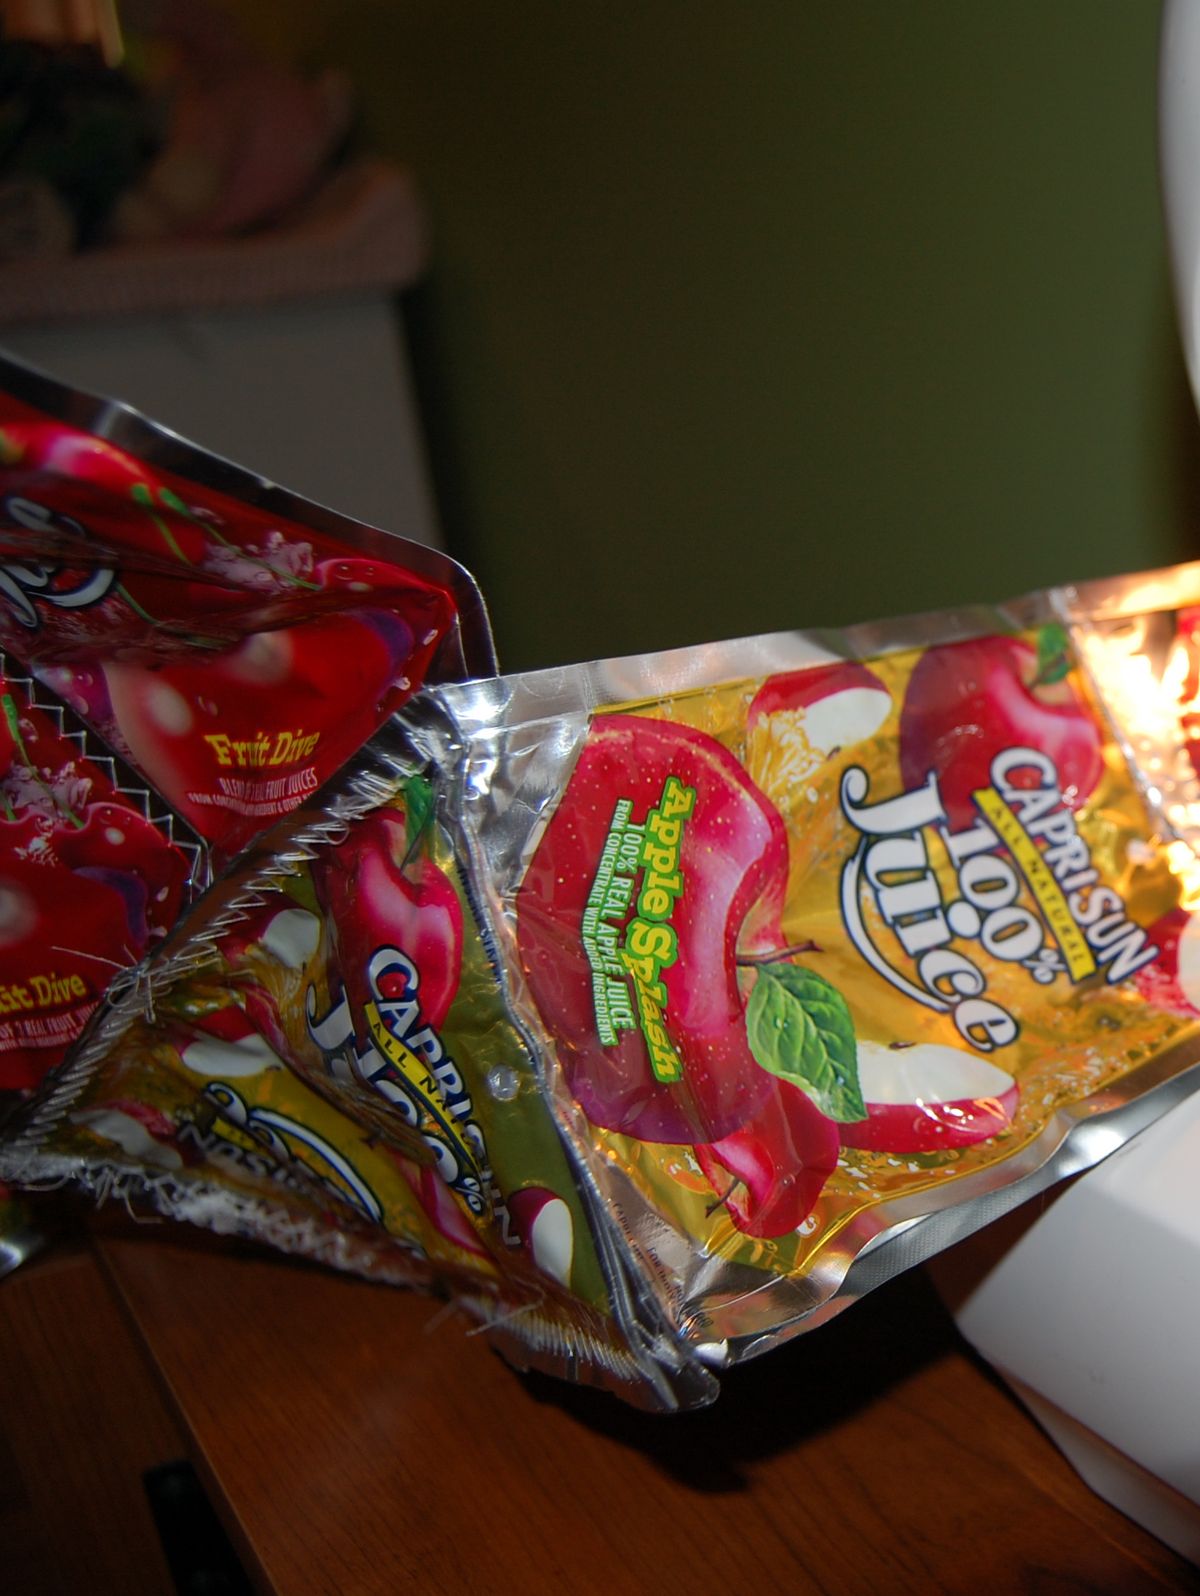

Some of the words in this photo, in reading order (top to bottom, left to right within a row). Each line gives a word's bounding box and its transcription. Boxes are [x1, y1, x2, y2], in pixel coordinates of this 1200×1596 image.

[204, 731, 271, 767] Fruit
[269, 728, 321, 766] Dive
[288, 766, 318, 797] JUICES
[610, 798, 632, 830] FROM
[587, 832, 622, 904] CONCENTRATE
[615, 823, 646, 874] 100%
[640, 779, 694, 916] Apple
[989, 746, 1099, 890] CAPRI
[1068, 886, 1161, 985] SUN
[600, 875, 633, 918] REAL
[840, 764, 1021, 1053] Juice
[939, 815, 1068, 985] 100%
[992, 807, 1024, 845] ALL
[1027, 858, 1087, 962] NATURAL
[582, 906, 600, 935] WITH
[582, 935, 604, 974] ADDED
[597, 922, 624, 976] APPLE
[29, 971, 87, 1007] Dive
[591, 972, 616, 1045] INGREDIENTS
[606, 975, 637, 1029] JUICE
[620, 921, 681, 1078] Splash
[368, 939, 473, 1122] CAPRI
[372, 1021, 409, 1070] ALL
